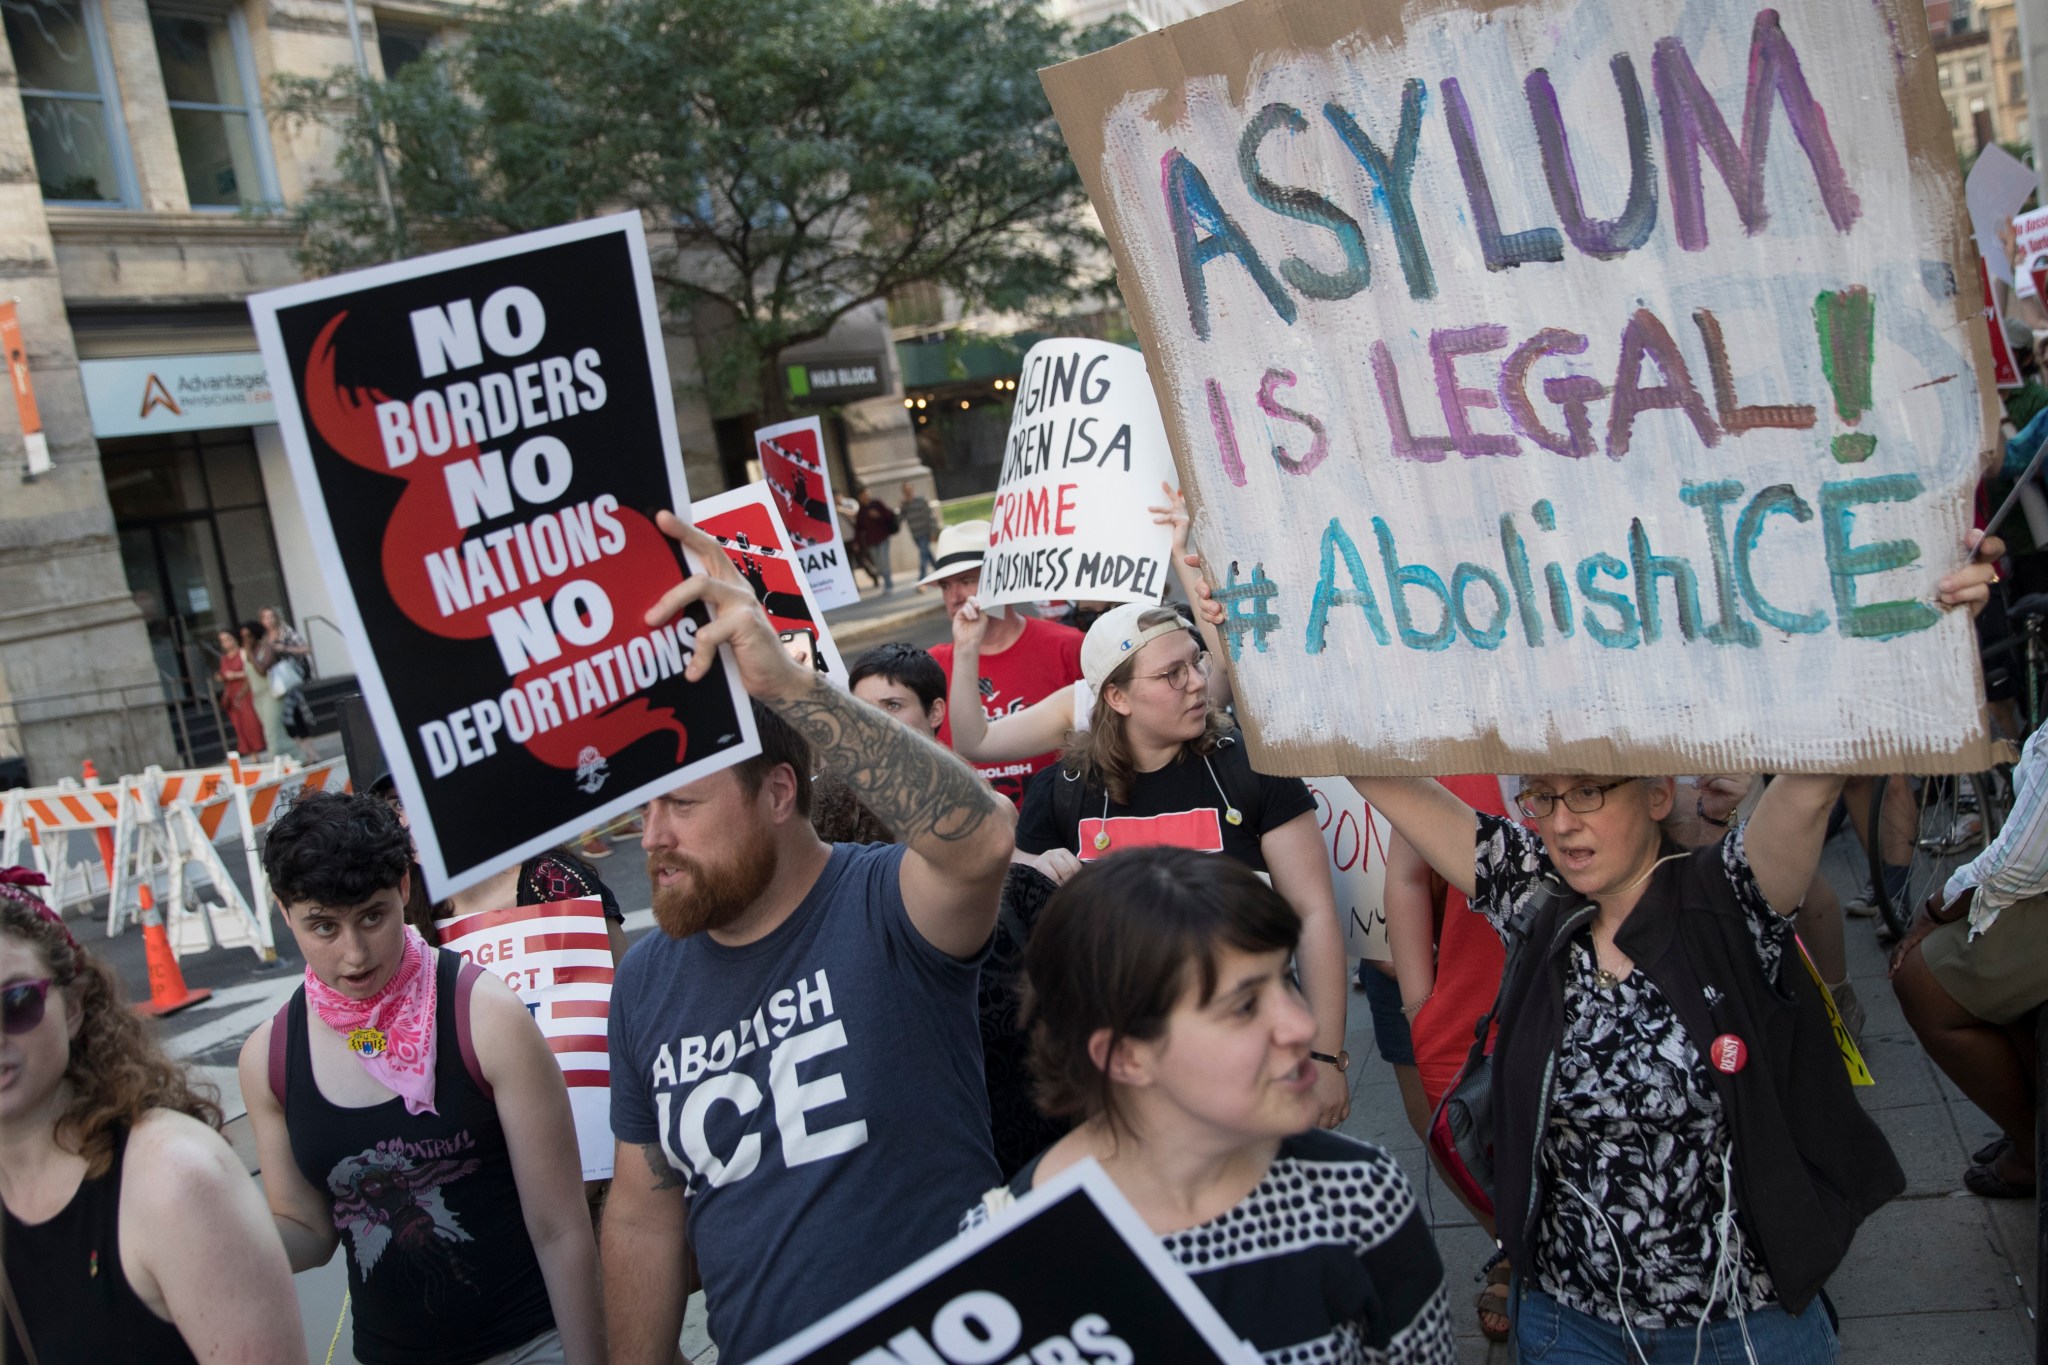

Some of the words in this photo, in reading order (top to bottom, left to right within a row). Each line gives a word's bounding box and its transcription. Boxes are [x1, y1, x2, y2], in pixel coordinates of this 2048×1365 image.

[1160, 8, 1864, 342] ASYLUM
[409, 285, 547, 379] NO
[837, 366, 877, 386] BLOCK
[375, 347, 608, 469] BORDERS
[1206, 369, 1329, 487] IS
[1371, 285, 1876, 463] LEGAL!
[443, 435, 574, 531] NO
[989, 483, 1079, 548] CRIME
[424, 494, 627, 617] NATIONS
[993, 547, 1074, 598] BUSINESS
[1074, 551, 1159, 598] MODEL
[487, 578, 614, 677] NO
[418, 617, 698, 780] DEPORTATIONS
[977, 763, 1033, 779] BOLISH
[652, 968, 834, 1089] ABOLISH
[1719, 1037, 1740, 1073] RESIST
[654, 1018, 869, 1197] ICE
